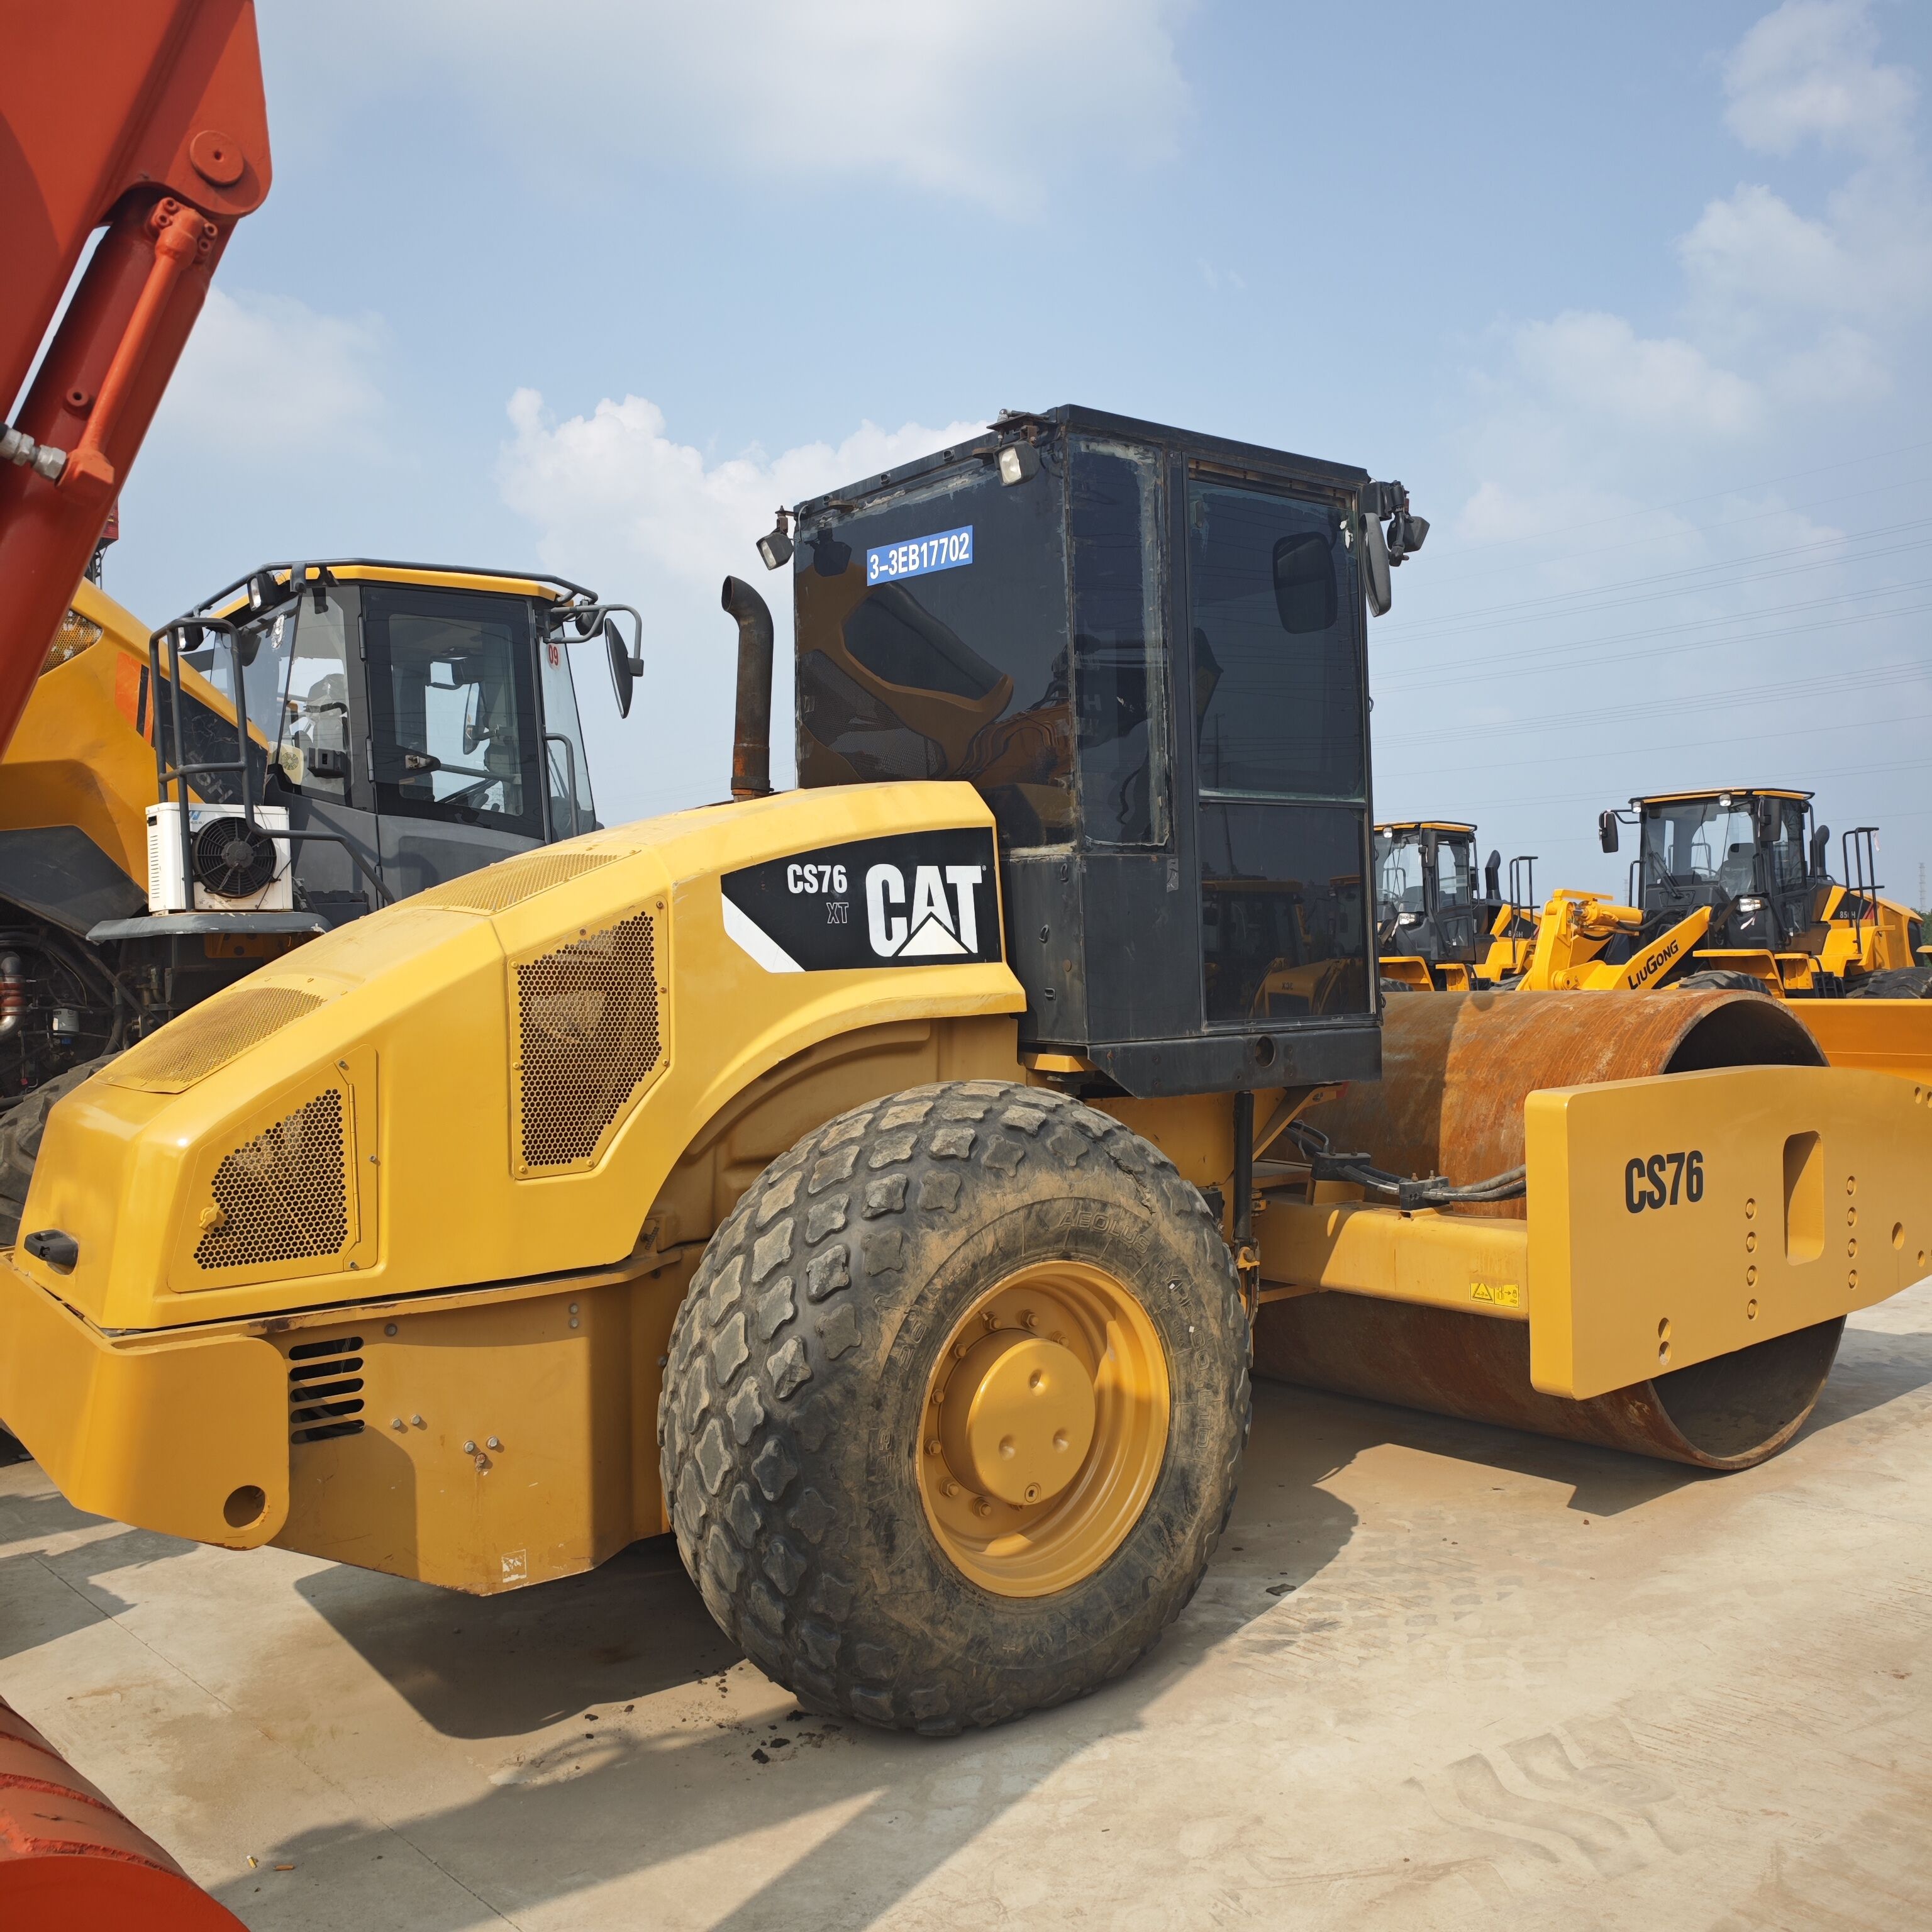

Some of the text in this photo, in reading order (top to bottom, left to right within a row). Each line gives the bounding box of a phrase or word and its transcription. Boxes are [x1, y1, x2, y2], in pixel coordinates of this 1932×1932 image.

[870, 532, 970, 580] 3-3EB17702
[787, 863, 848, 894] CS76
[826, 902, 849, 924] XT
[865, 863, 982, 957] CAT
[1840, 911, 1856, 919] 85H
[1507, 930, 1523, 938] 86H
[1625, 1150, 1704, 1214] CS76
[1057, 1211, 1152, 1255] AEOLUS
